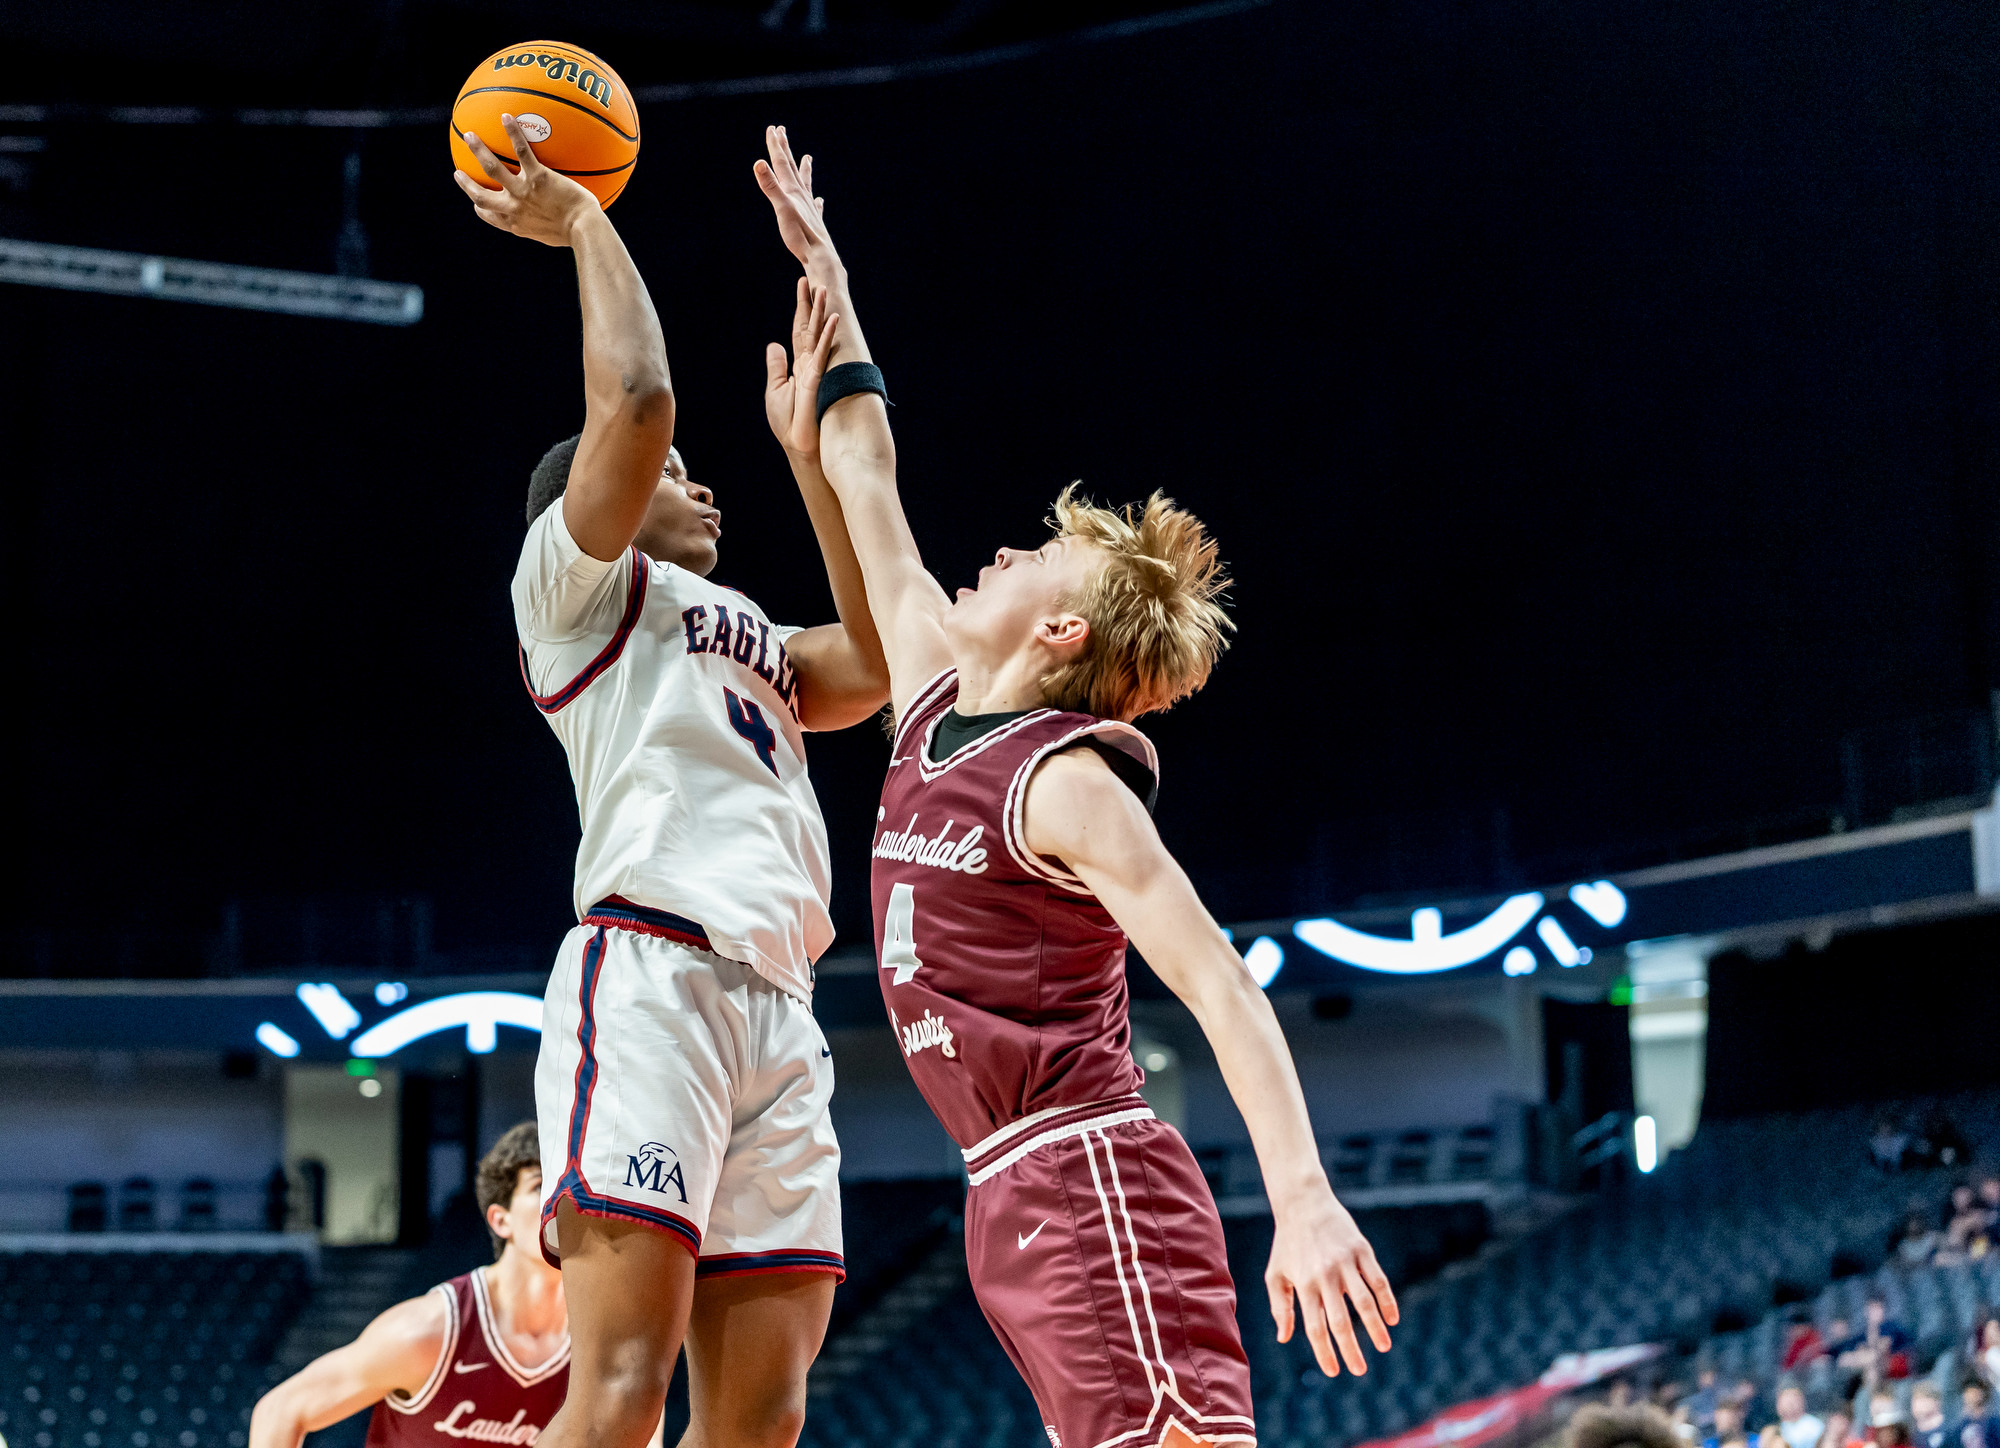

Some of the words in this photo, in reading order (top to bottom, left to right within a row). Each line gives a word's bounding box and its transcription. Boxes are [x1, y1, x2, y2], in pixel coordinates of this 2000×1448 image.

[493, 53, 613, 109] Wilson
[723, 685, 780, 780] 4
[881, 882, 924, 987] 4
[622, 1153, 690, 1205] MA
